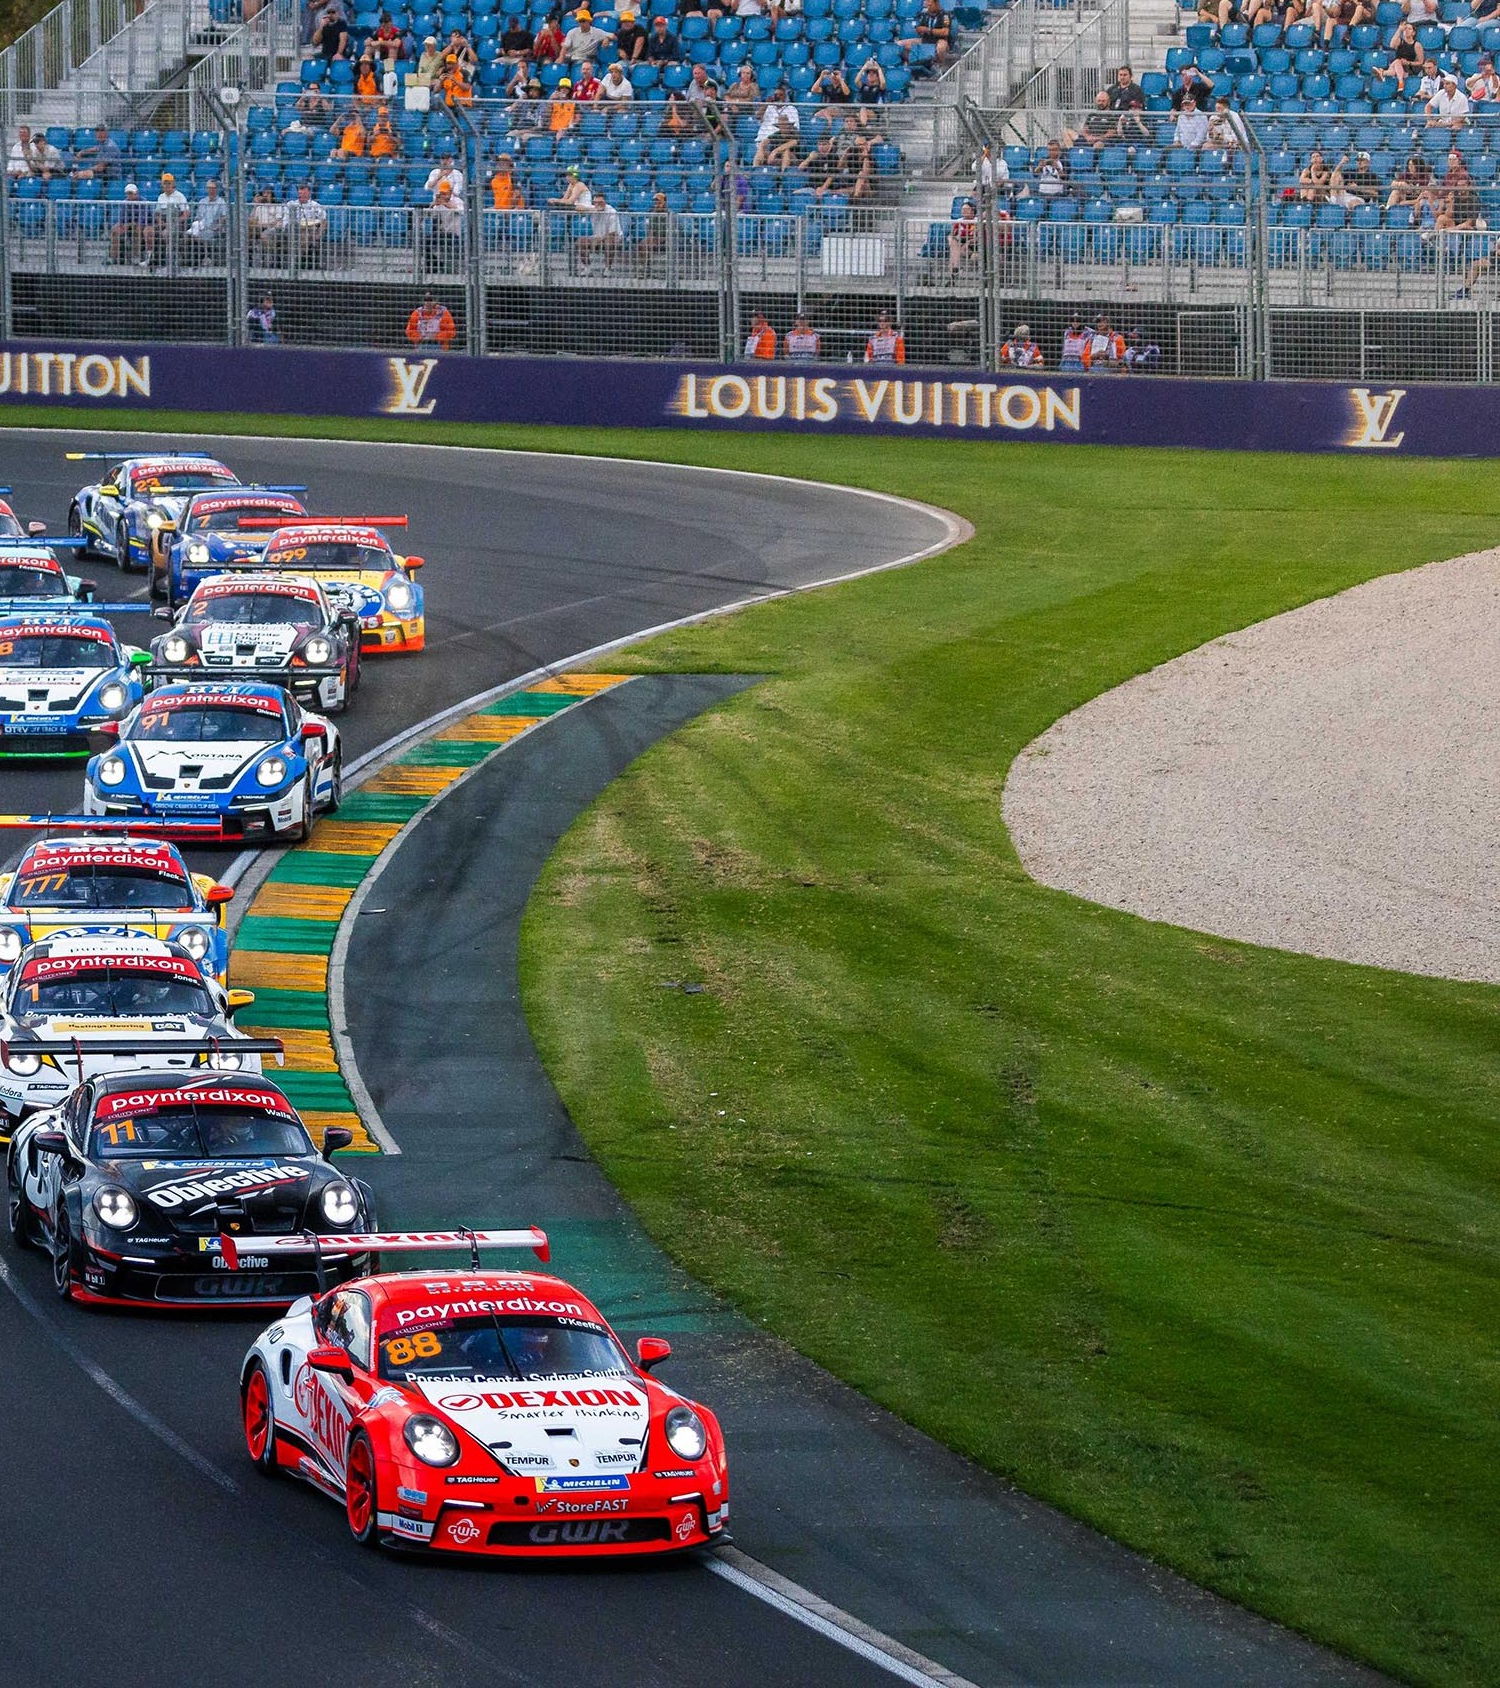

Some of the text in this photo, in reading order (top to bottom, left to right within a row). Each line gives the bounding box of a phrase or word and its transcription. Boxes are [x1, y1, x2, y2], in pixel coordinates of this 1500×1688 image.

[682, 373, 1080, 431] LOUIS VUITTON
[200, 498, 294, 511] paynterdixon
[279, 534, 379, 547] paynterdixon
[203, 584, 310, 597] paynterdixon
[191, 600, 209, 617] 2
[151, 695, 270, 709] paynterdixon
[140, 711, 170, 732] 91
[33, 853, 170, 870] paynterdixon
[19, 872, 69, 899] 777
[36, 955, 186, 974] paynterdixon
[172, 972, 198, 985] Jones
[25, 983, 41, 1003] 1
[155, 1023, 183, 1031] CAT
[111, 1088, 277, 1112] paynterdixon
[100, 1119, 137, 1146] 11
[147, 1165, 310, 1208] Objective
[211, 1255, 269, 1270] Obctive
[396, 1297, 583, 1327] paynterdixon
[557, 1315, 603, 1332] O'Keeffe
[385, 1331, 443, 1366] 88
[470, 1373, 526, 1383] Centr
[580, 1367, 622, 1379] South
[479, 1388, 641, 1410] DEXION
[498, 1408, 643, 1421] Smarter thinking.
[505, 1455, 550, 1466] TEMPUR
[596, 1452, 638, 1464] TEMPUR
[562, 1477, 621, 1488] MICHELIN
[556, 1498, 629, 1514] StoreFAST
[447, 1523, 481, 1537] GWR
[528, 1519, 631, 1544] GWR
[675, 1519, 696, 1536] GWR
